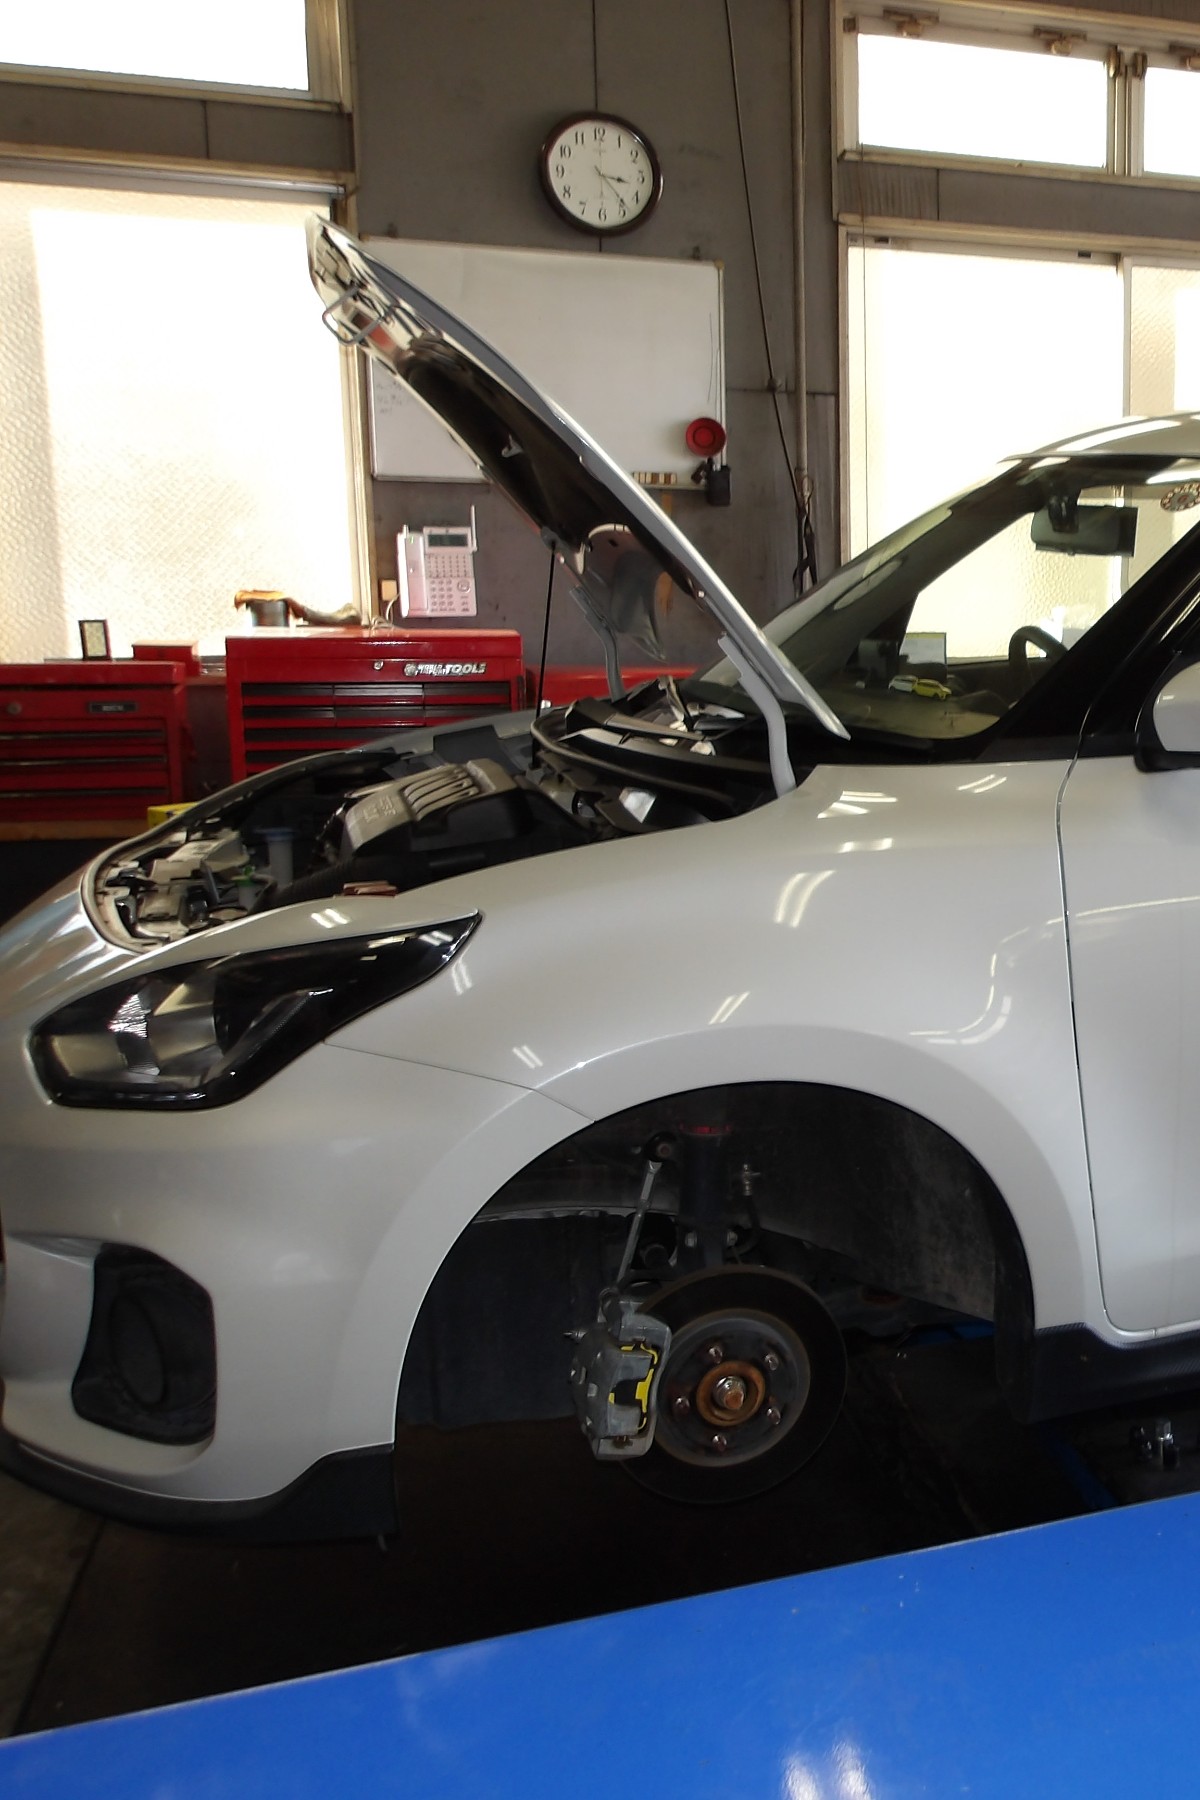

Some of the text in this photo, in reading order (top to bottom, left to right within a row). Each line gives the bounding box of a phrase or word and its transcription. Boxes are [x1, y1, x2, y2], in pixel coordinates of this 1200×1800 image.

[574, 131, 585, 145] 11
[593, 127, 606, 142] 12
[560, 145, 571, 158] 10
[630, 149, 639, 163] 2
[556, 164, 565, 178] 9
[637, 169, 645, 184] 3
[563, 185, 571, 199] 8
[632, 190, 640, 204] 4
[579, 200, 587, 215] 7
[598, 208, 607, 221] 6
[619, 203, 627, 218] 5
[445, 664, 486, 674] TOOLS
